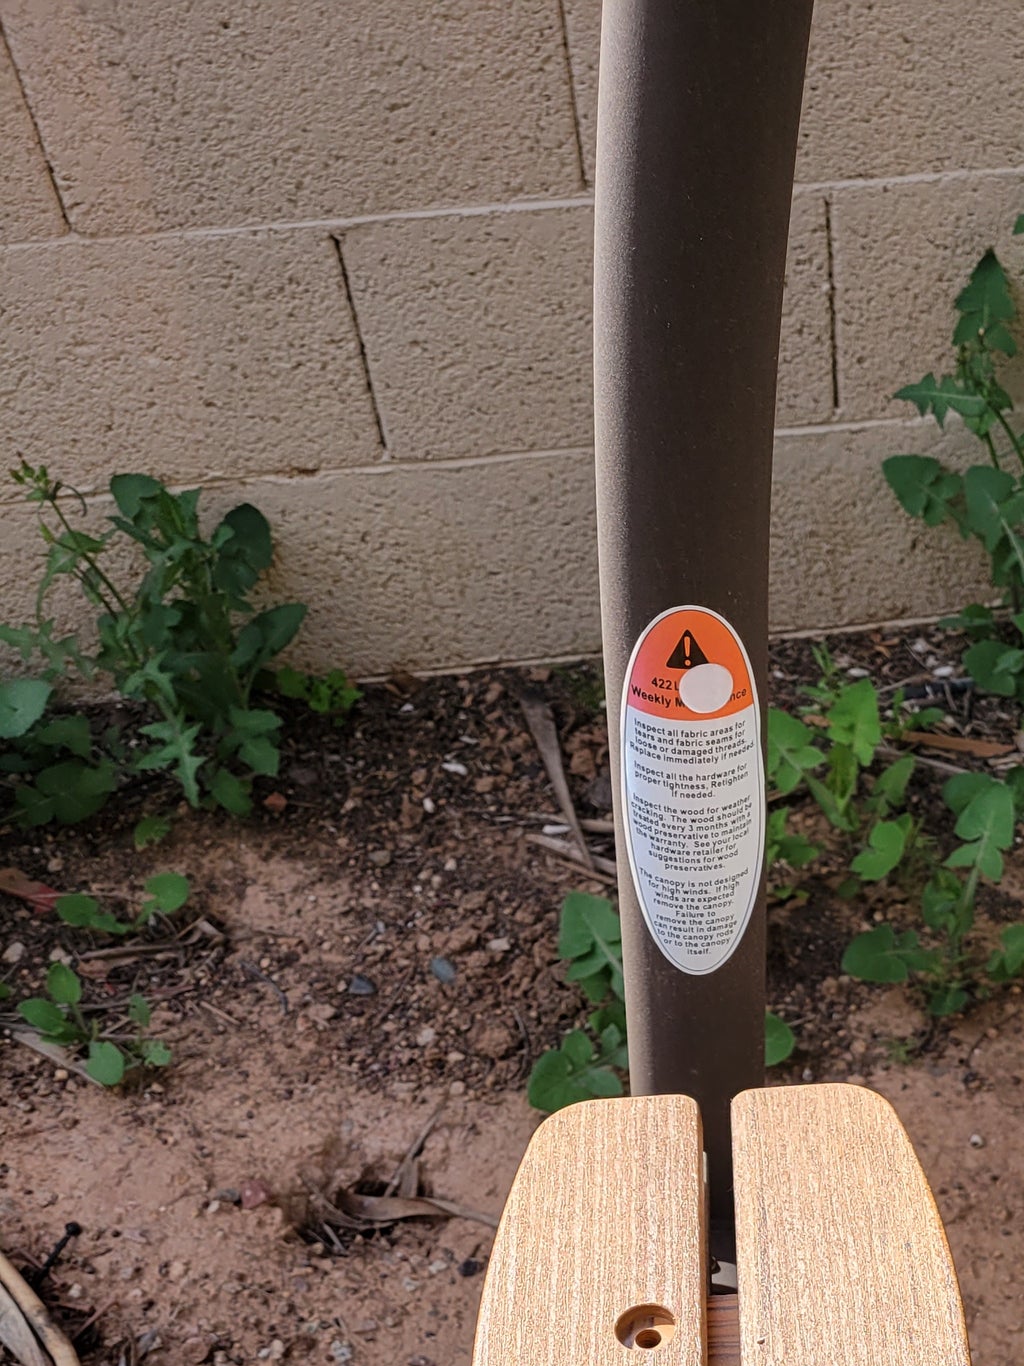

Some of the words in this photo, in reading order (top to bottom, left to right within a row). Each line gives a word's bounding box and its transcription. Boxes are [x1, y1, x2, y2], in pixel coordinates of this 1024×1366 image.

[651, 677, 672, 690] 422
[632, 685, 671, 708] Weekly
[634, 718, 665, 736] Inspect
[681, 730, 708, 738] fabric
[710, 726, 733, 736] areas
[735, 720, 746, 729] for
[635, 727, 655, 741] tears
[657, 737, 673, 745] and
[676, 739, 702, 747] fabric
[706, 735, 732, 745] seams
[735, 730, 745, 739] for
[630, 741, 661, 760] Replace
[664, 755, 719, 764] immediately
[636, 736, 657, 750] loose
[671, 746, 713, 757] damaged
[634, 761, 664, 778] Inspect
[666, 771, 676, 780] all
[679, 771, 693, 781] the
[696, 768, 736, 781] hardware
[737, 763, 747, 773] for
[635, 771, 661, 785] proper
[711, 771, 748, 788] Retighten
[633, 792, 661, 811] Inspect
[664, 804, 677, 814] the
[722, 795, 751, 811] weather
[633, 810, 659, 826] treated
[662, 823, 685, 832] every
[696, 820, 728, 831] months
[731, 815, 746, 826] with
[671, 815, 687, 823] The
[690, 816, 714, 824] wood
[717, 805, 743, 821] should
[633, 820, 652, 831] wood
[654, 826, 708, 840] preservative
[636, 827, 647, 838] the
[712, 837, 731, 850] your
[733, 829, 749, 840] local
[649, 850, 700, 864] suggestions
[718, 850, 738, 861] wood
[651, 843, 690, 856] hardware
[693, 847, 724, 856] retailer
[726, 843, 736, 851] for
[640, 868, 652, 879] The
[655, 875, 685, 888] canopy
[714, 868, 749, 886] designed
[648, 880, 659, 889] for
[662, 885, 680, 895] high
[724, 881, 739, 892] high
[653, 898, 683, 909] remove
[655, 891, 679, 902] winds
[697, 892, 734, 904] expected
[654, 920, 667, 929] can
[670, 925, 694, 933] result
[707, 921, 737, 932] damage
[656, 914, 686, 925] remove
[706, 914, 734, 925] canopy
[657, 928, 665, 936] to
[668, 931, 680, 939] the
[716, 929, 734, 938] rods
[701, 938, 730, 948] canopy
